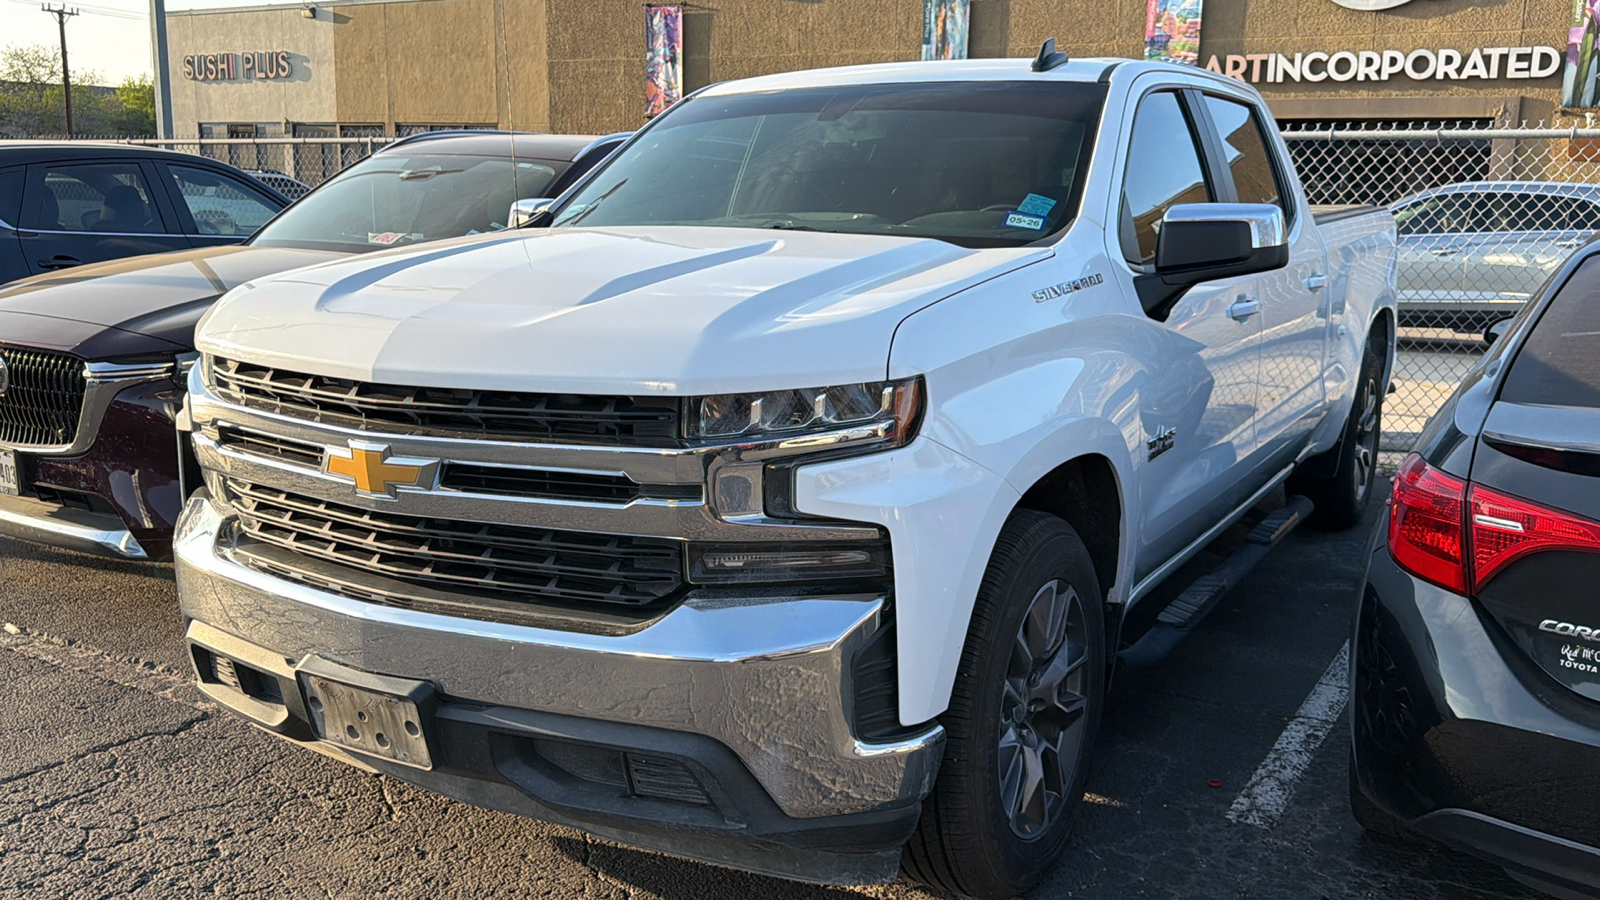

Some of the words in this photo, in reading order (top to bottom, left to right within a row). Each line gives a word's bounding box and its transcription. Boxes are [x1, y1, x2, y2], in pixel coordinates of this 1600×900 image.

[183, 53, 235, 80] SUSHI
[242, 51, 292, 78] PLUS
[1031, 273, 1104, 304] SILVERADO
[1560, 659, 1598, 673] TOYOTA
